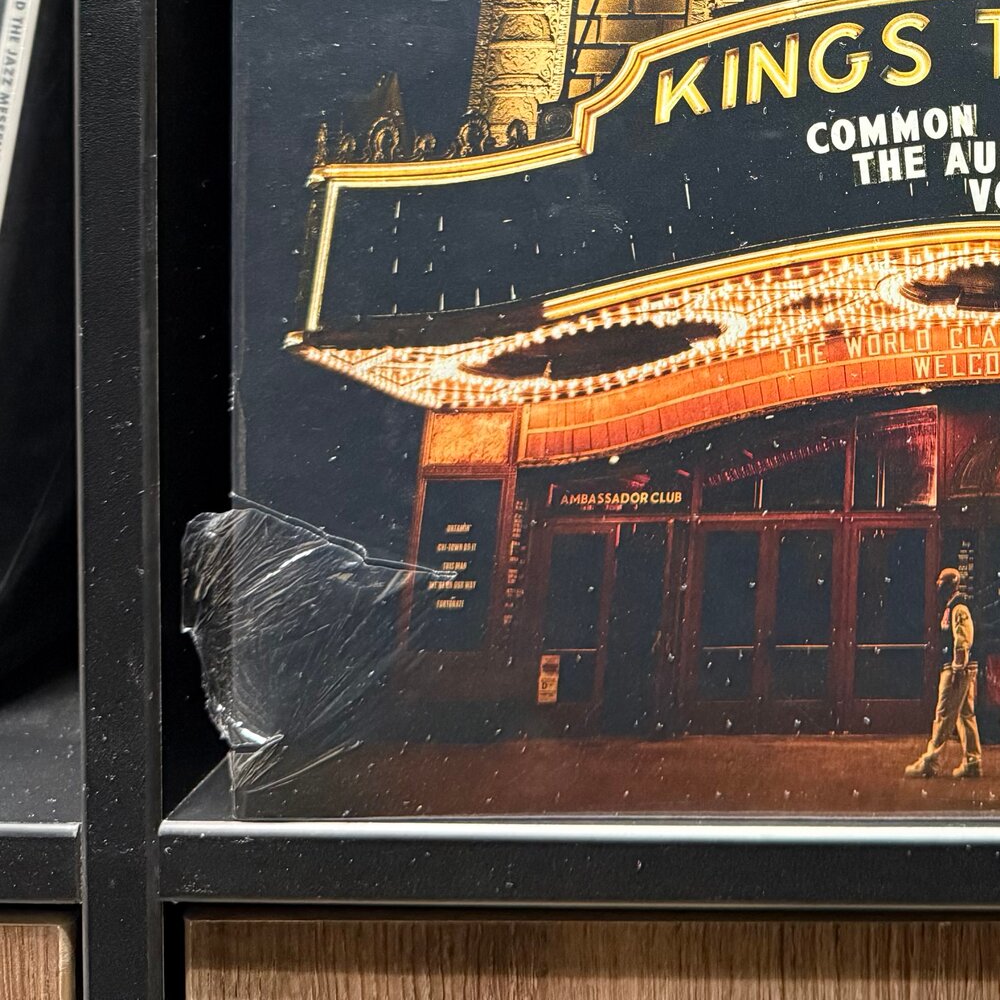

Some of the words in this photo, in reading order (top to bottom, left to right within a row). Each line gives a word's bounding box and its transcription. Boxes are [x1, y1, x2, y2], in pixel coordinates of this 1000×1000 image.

[9, 17, 23, 43] THE
[2, 49, 18, 86] JAZZ
[654, 12, 932, 126] KINGS
[806, 104, 977, 155] COMMON
[851, 144, 927, 186] THE
[779, 342, 828, 370] THE
[845, 329, 931, 359] WORLD
[560, 491, 649, 505] AMBASSADOR
[650, 491, 683, 504] CLUB
